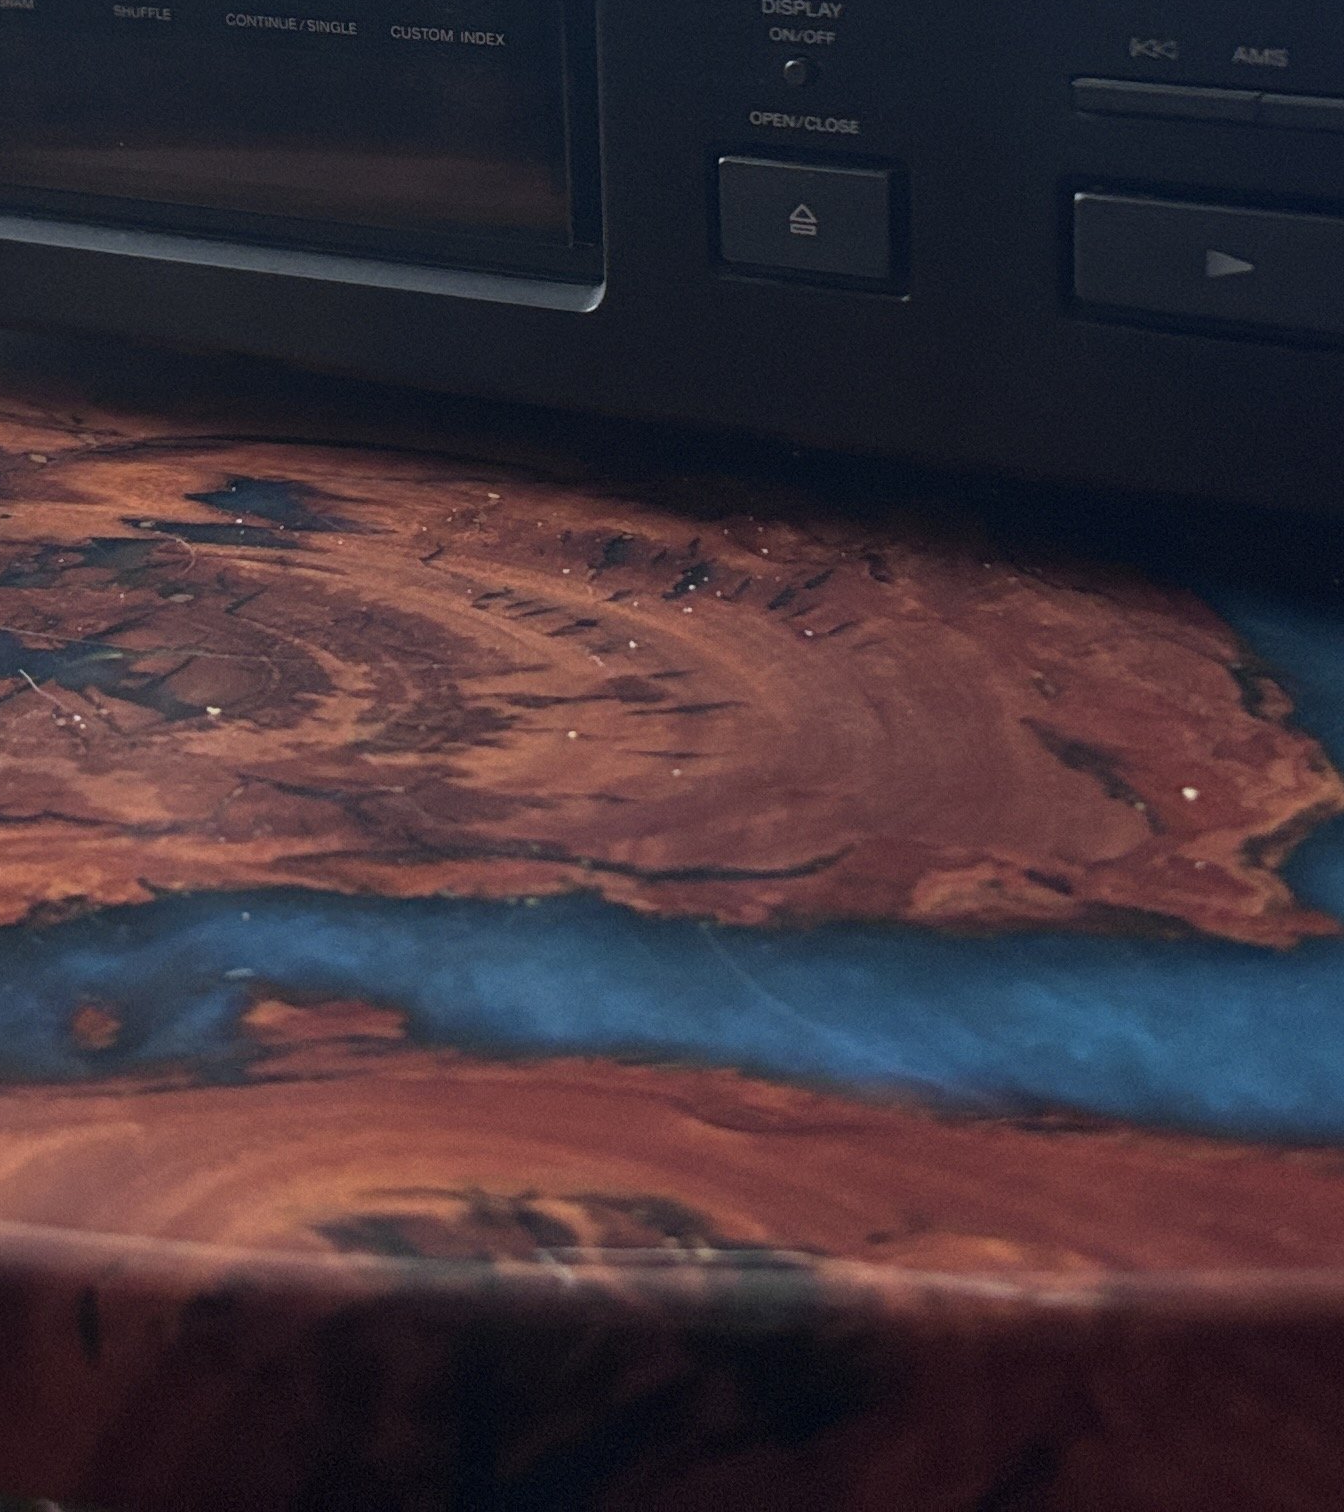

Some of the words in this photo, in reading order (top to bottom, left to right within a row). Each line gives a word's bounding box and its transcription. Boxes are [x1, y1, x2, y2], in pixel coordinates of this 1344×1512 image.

[113, 4, 172, 21] SHUFFLE
[225, 13, 358, 36] CONTINUE/SINGLE
[390, 25, 455, 43] CUSTOM
[460, 30, 506, 47] INDEX
[768, 27, 837, 45] ON/OFF
[749, 111, 861, 135] OPEN/CLOSE
